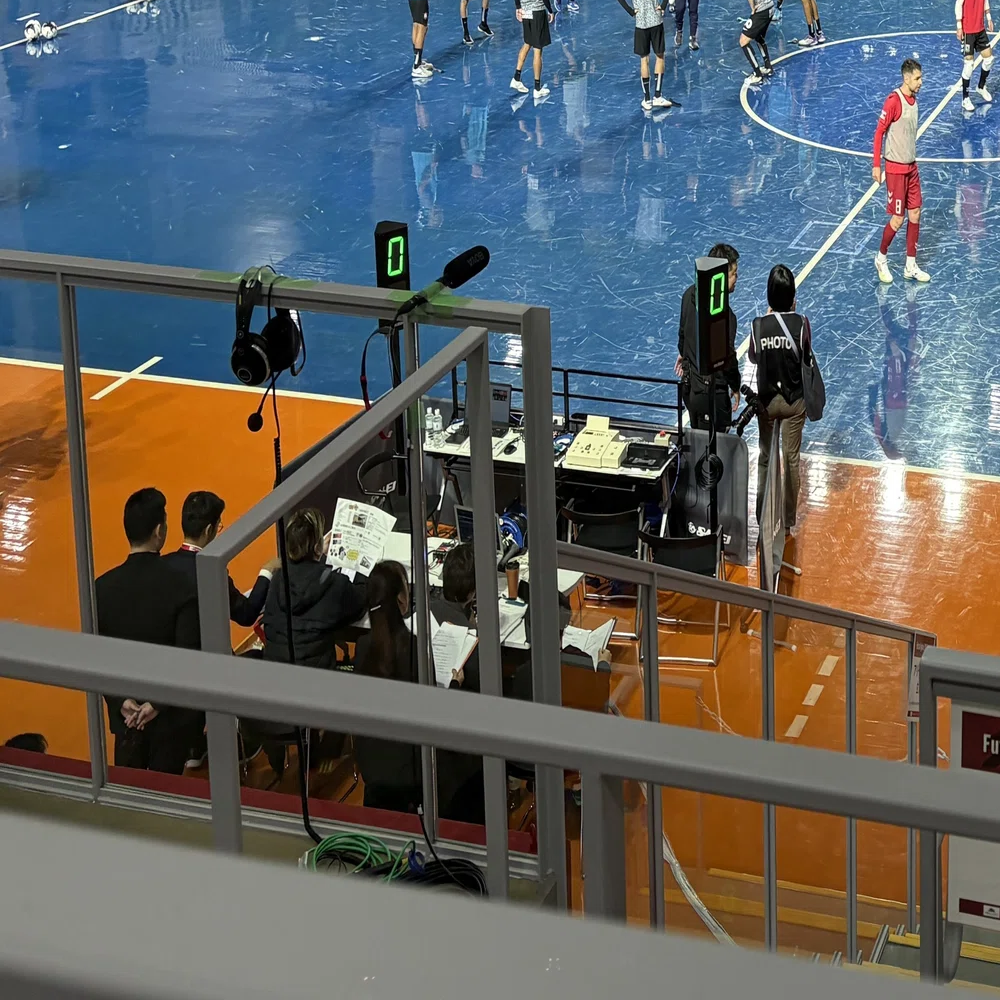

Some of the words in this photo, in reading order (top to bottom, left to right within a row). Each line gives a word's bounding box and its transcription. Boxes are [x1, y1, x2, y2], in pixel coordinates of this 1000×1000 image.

[388, 236, 404, 276] 0
[710, 272, 725, 315] 0
[761, 336, 792, 350] PHOTO
